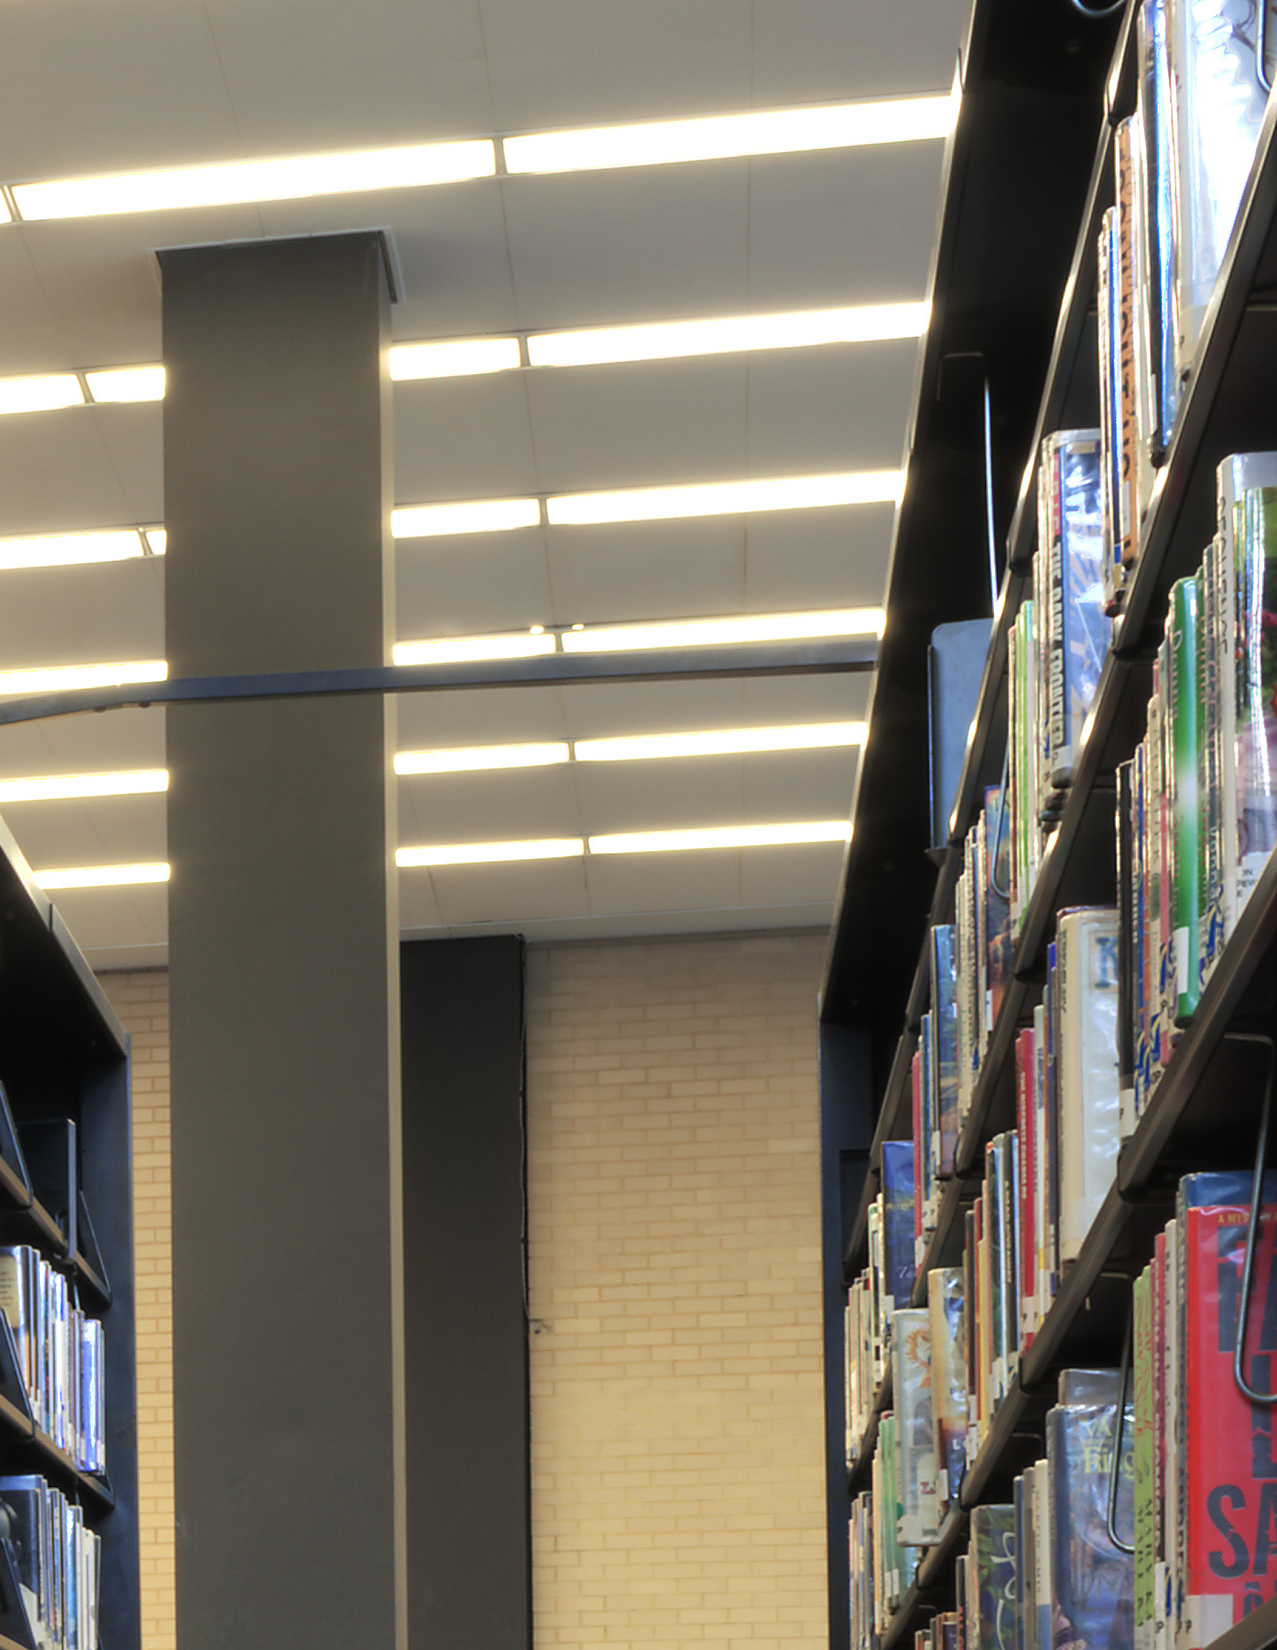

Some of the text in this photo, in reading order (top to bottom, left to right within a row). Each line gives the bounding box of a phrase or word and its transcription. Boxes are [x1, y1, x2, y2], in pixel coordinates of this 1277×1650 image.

[1050, 541, 1065, 746] THE DARK FRONTIER
